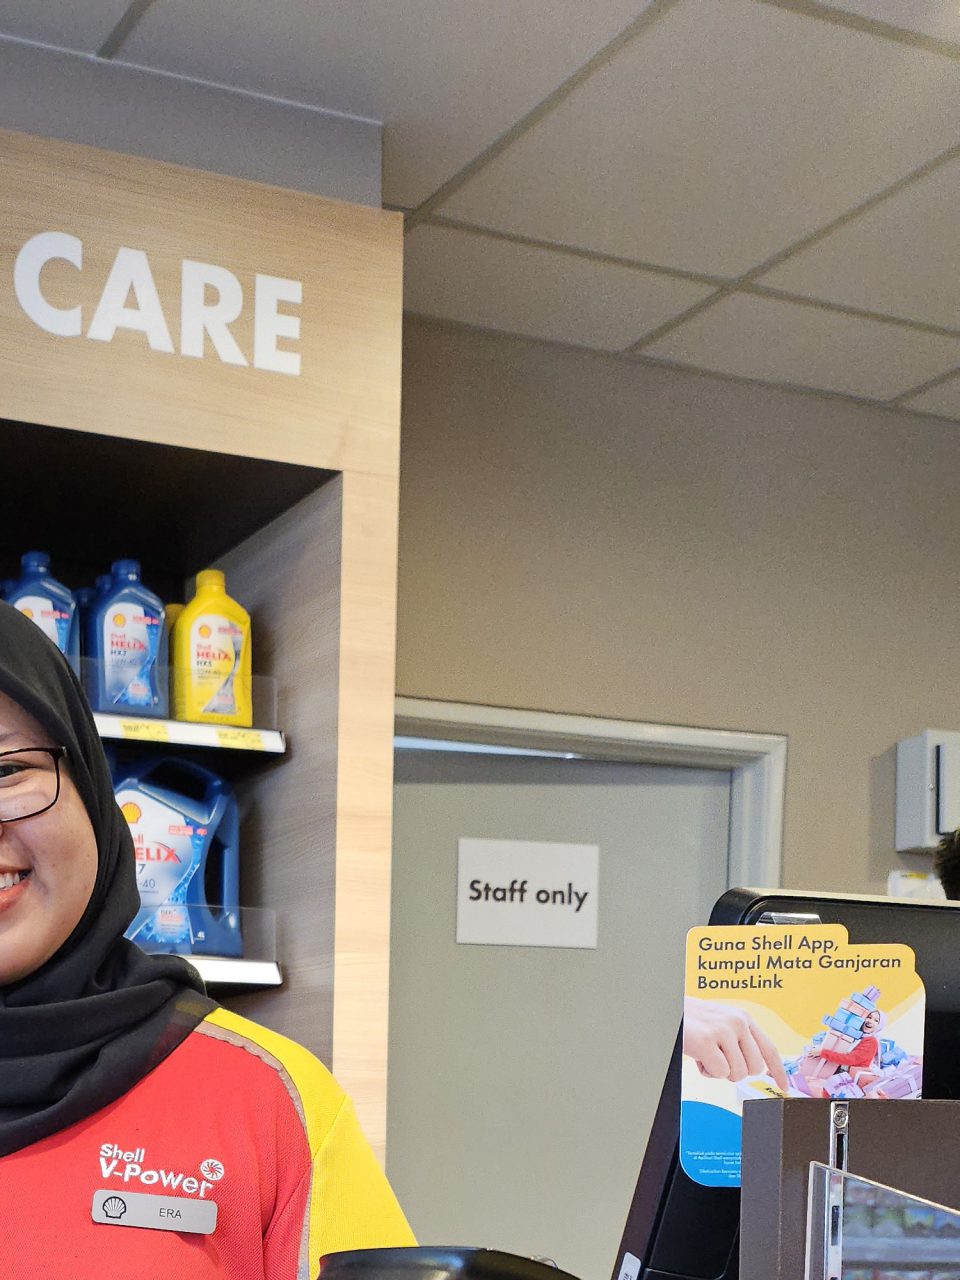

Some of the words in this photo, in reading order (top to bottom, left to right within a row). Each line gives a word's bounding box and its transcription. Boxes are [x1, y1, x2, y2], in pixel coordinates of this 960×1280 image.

[14, 231, 302, 376] CARE
[111, 640, 146, 650] HELIX
[196, 651, 231, 661] HELIX
[135, 847, 181, 864] ELIX
[469, 879, 528, 903] Staff
[535, 883, 589, 913] only
[698, 936, 746, 951] Guna
[751, 935, 792, 950] Shell
[798, 936, 840, 952] App,
[698, 954, 761, 973] kumpul
[766, 956, 812, 970] Mata
[818, 956, 901, 972] Ganjaran
[698, 974, 784, 990] BonusLink
[100, 1143, 145, 1162] Shell
[99, 1157, 214, 1197] V-Power
[159, 1208, 182, 1219] ERA
